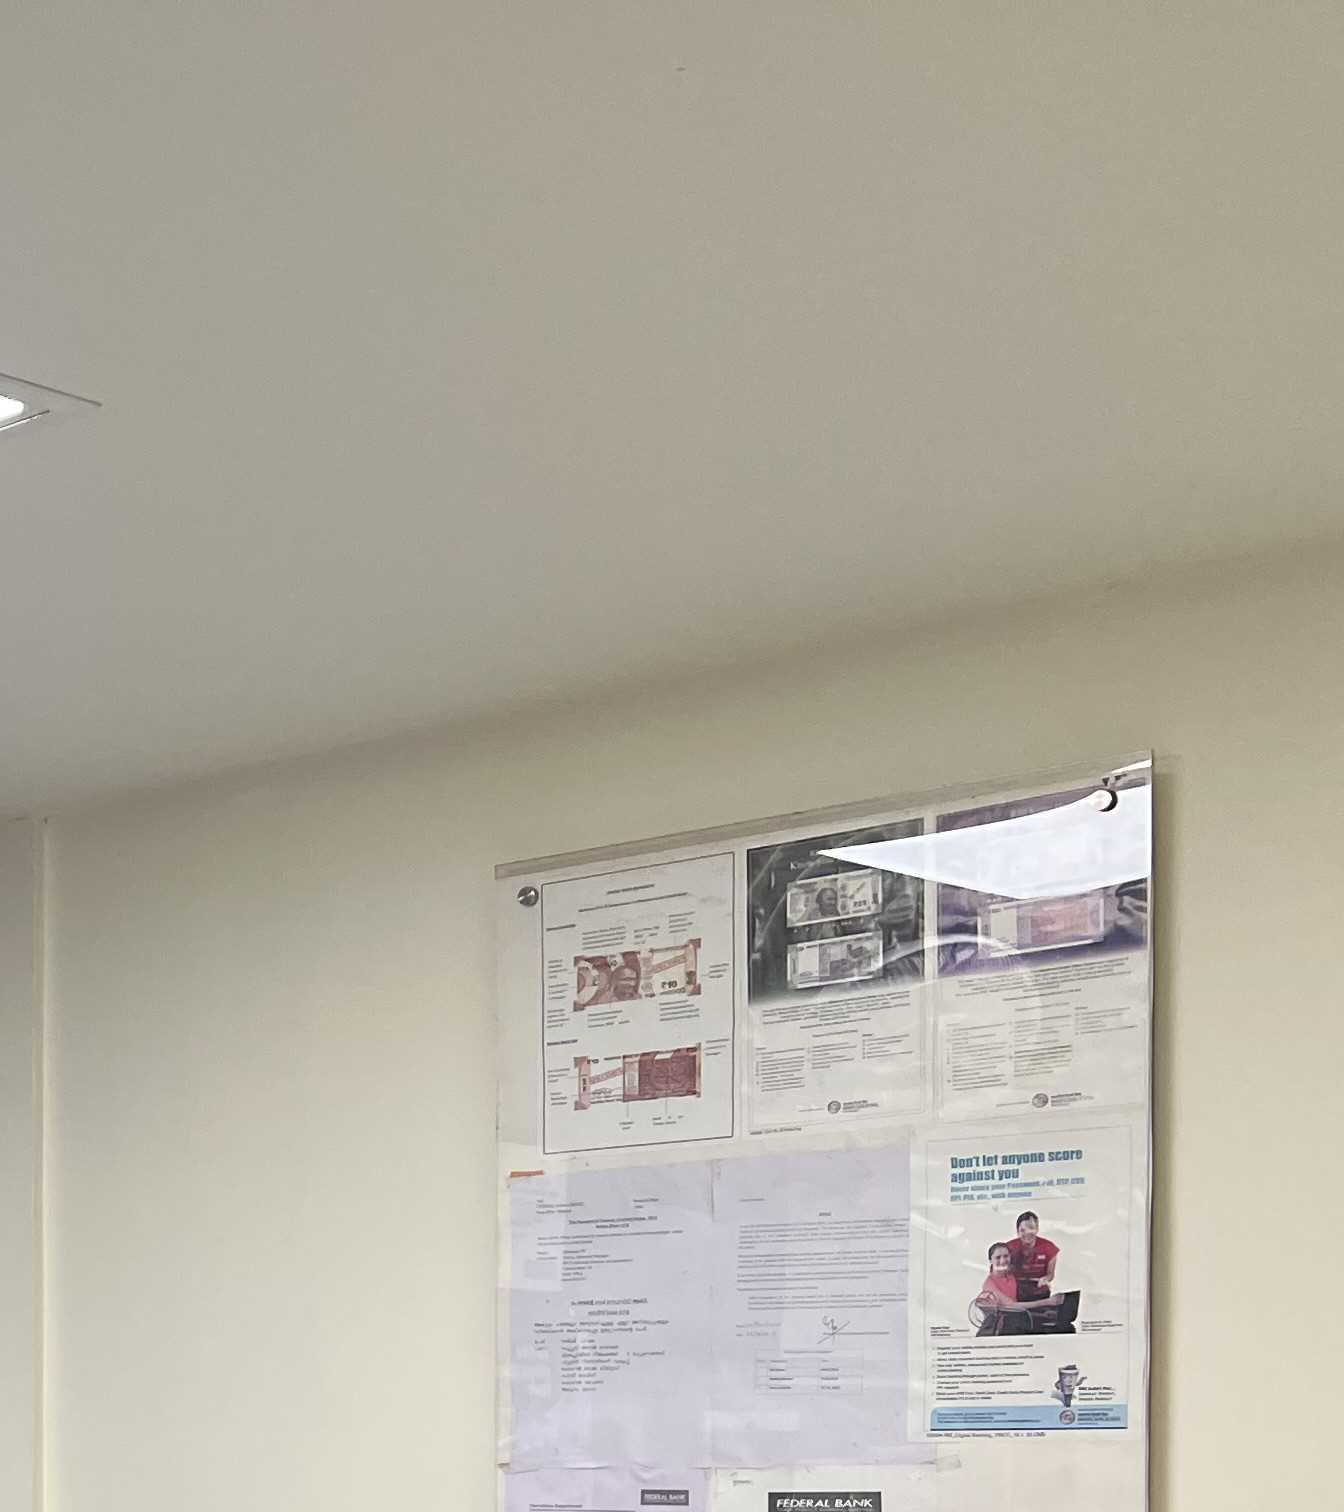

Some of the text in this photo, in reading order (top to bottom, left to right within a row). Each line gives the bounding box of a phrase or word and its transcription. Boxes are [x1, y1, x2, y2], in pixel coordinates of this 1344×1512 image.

[951, 1150, 1083, 1168] Don't let anyone score
[951, 1168, 1019, 1183] against you
[776, 1499, 873, 1508] FEDERAL BANK
